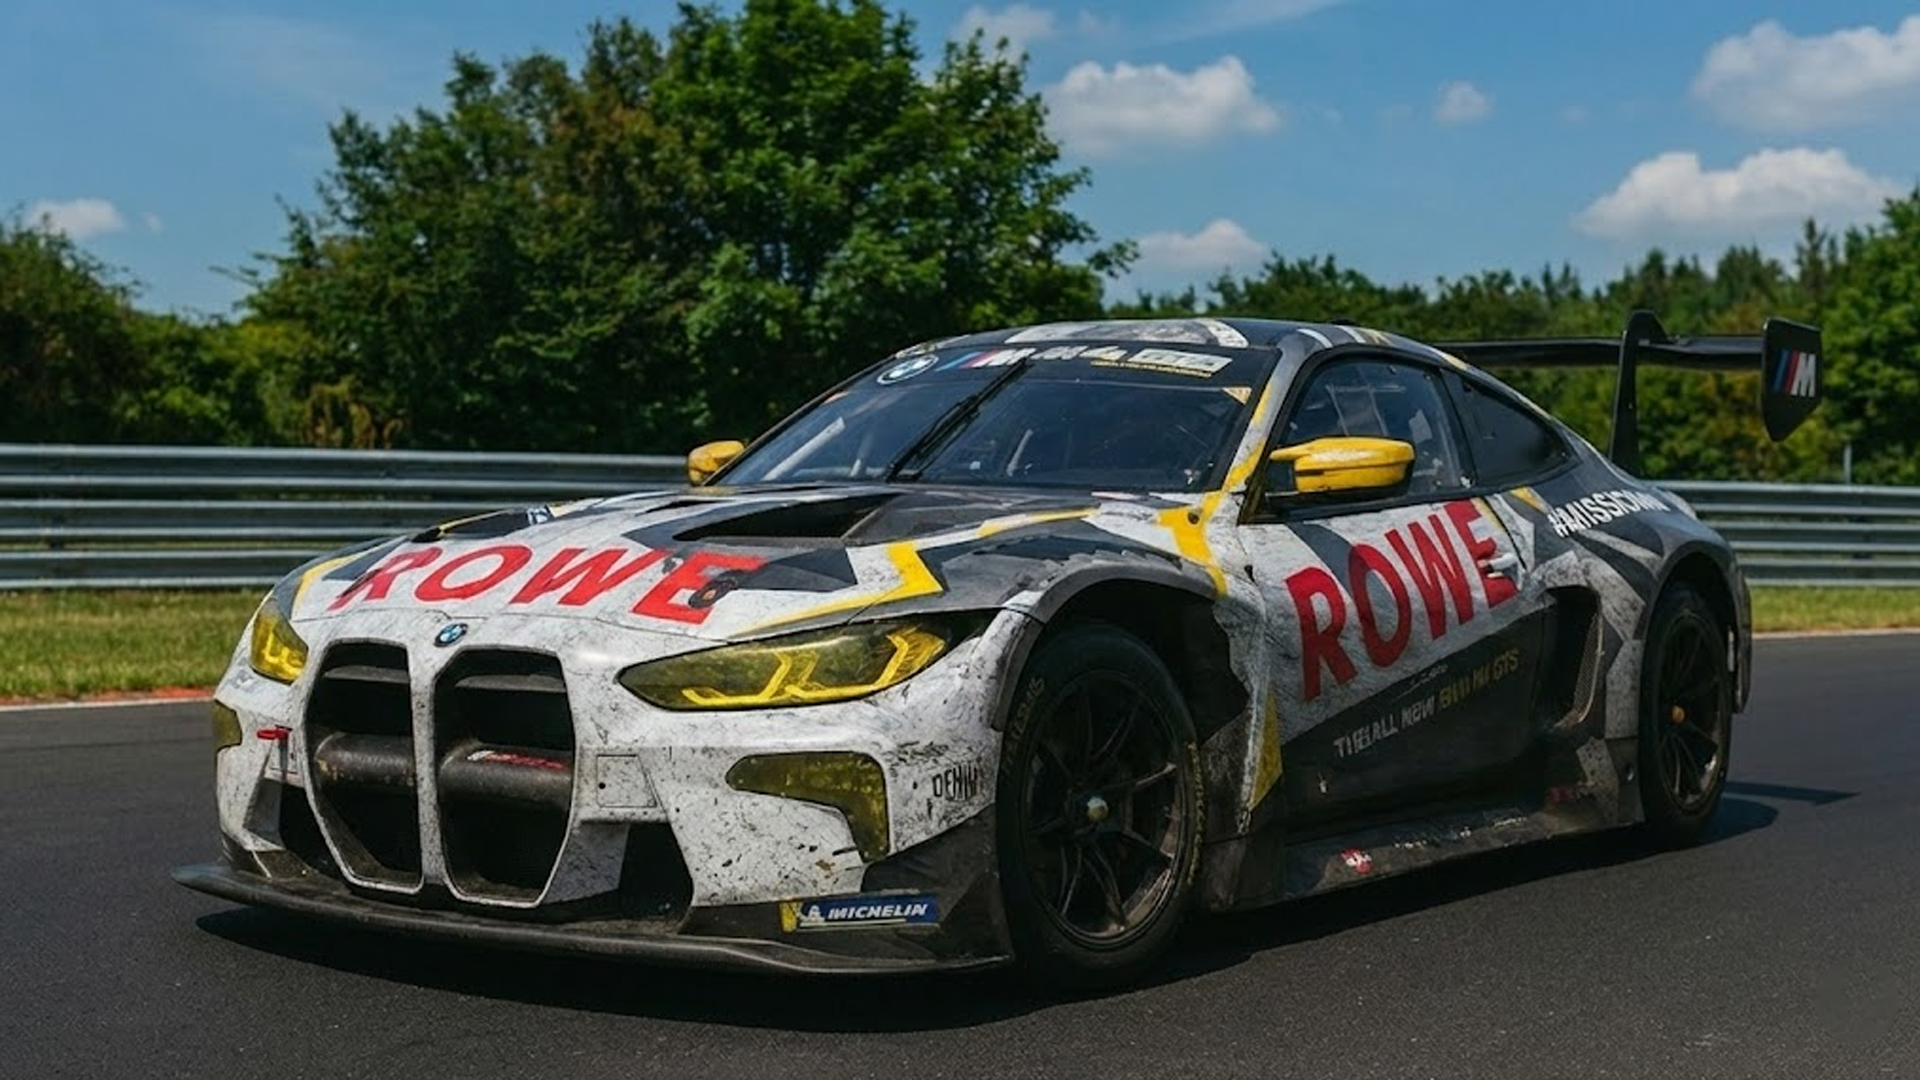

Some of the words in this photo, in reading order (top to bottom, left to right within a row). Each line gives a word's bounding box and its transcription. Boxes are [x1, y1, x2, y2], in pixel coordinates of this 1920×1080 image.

[327, 545, 769, 625] ROWE
[1285, 498, 1518, 700] ROWE
[827, 903, 929, 920] MICHELIN
